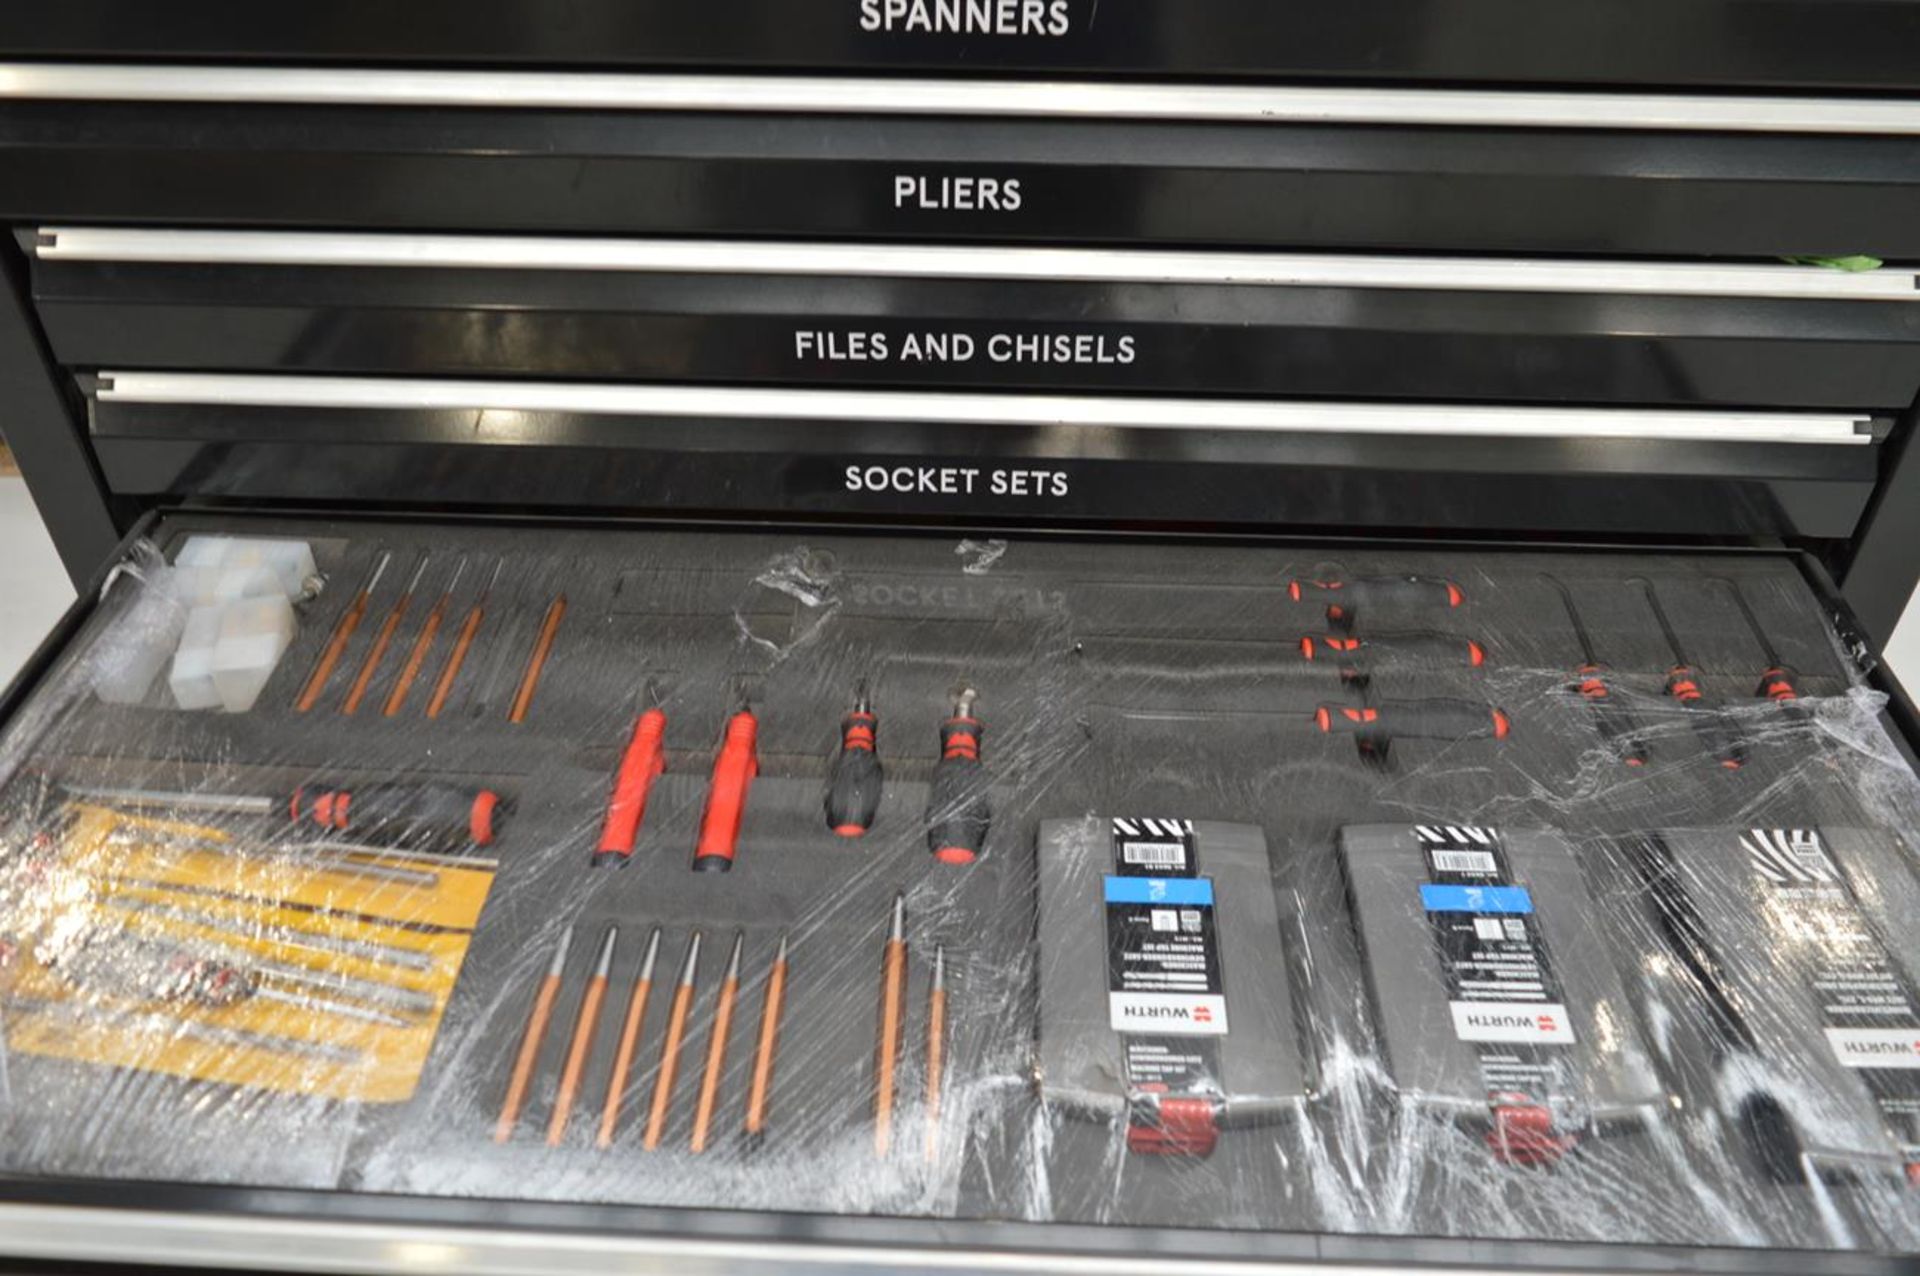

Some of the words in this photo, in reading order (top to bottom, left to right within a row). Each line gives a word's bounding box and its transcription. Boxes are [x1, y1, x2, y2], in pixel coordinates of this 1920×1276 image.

[860, 0, 1069, 36] SPANNERS
[894, 176, 1022, 211] PLIERS
[795, 331, 889, 360] FILES
[900, 333, 975, 362] AND
[987, 334, 1136, 364] CHISELS
[845, 465, 980, 494] SOCKET
[990, 469, 1069, 497] SETS
